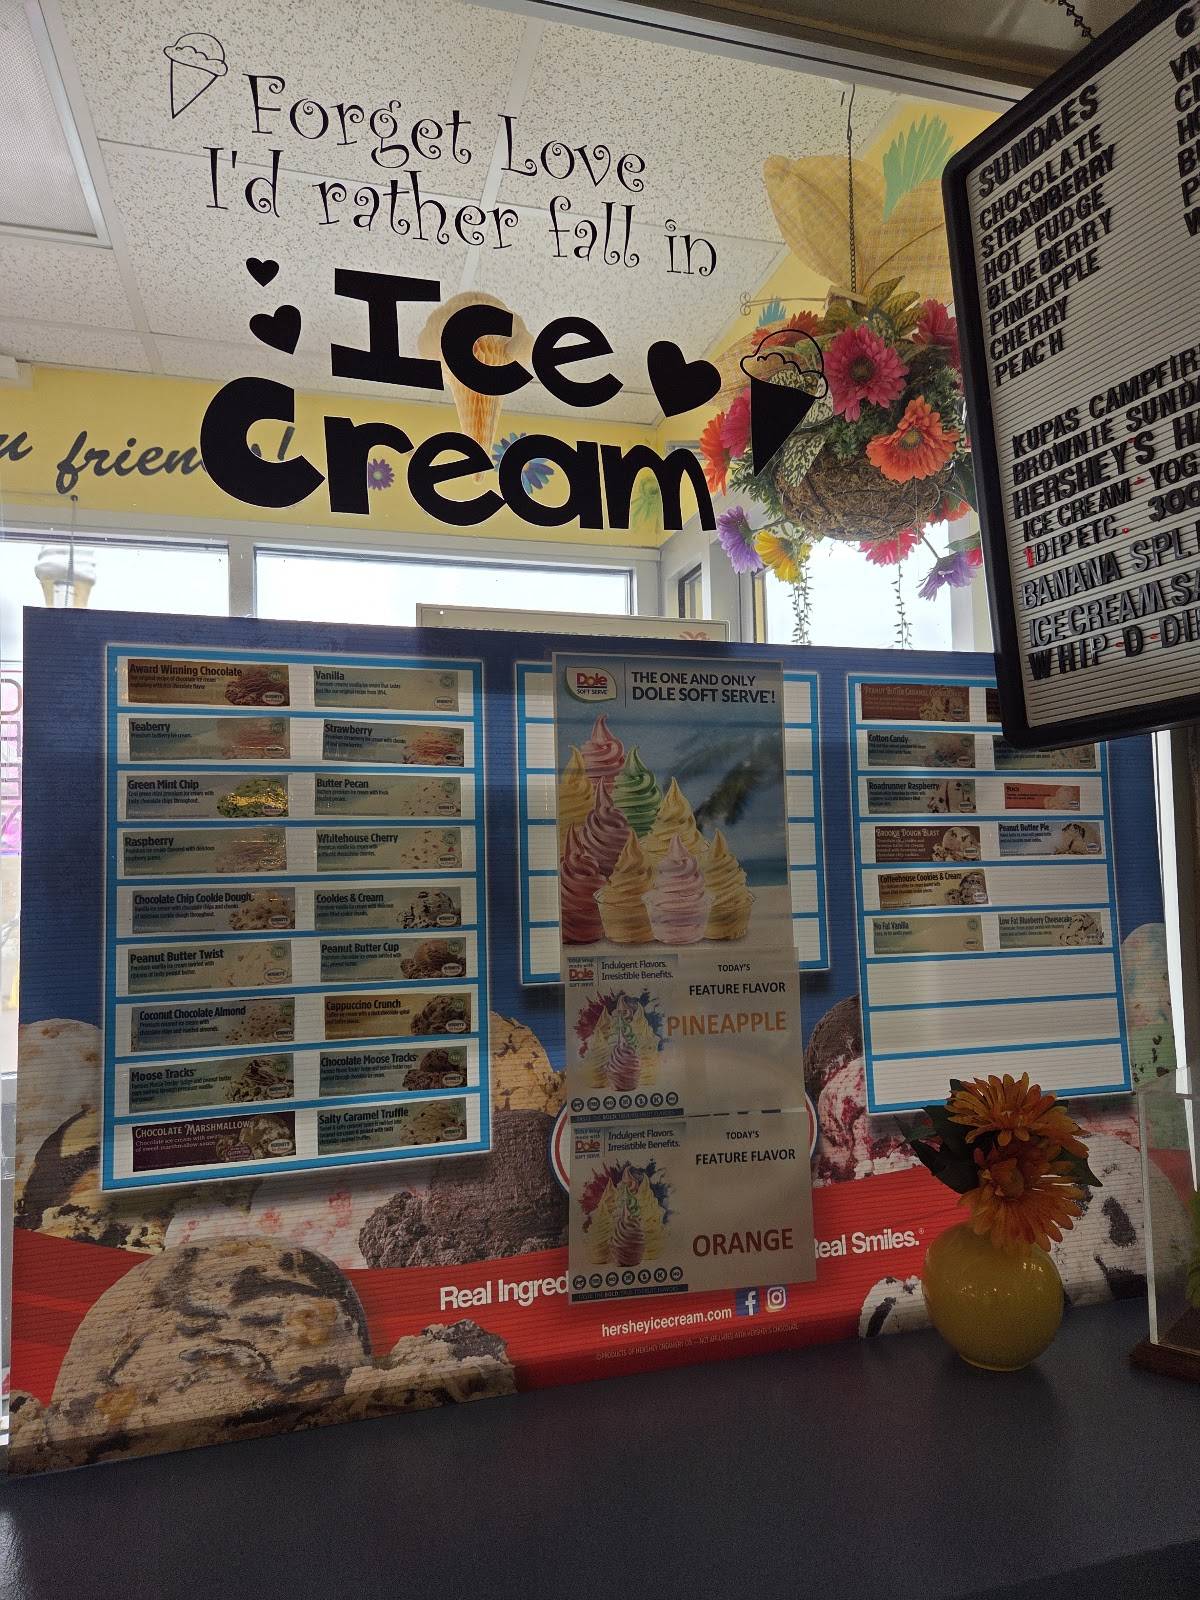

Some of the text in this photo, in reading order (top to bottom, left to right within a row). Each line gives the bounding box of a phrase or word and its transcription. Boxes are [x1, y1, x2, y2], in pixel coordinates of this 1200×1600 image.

[243, 73, 645, 192] Forget Love
[979, 84, 1100, 197] SUNDAES
[979, 123, 1103, 232] CHOCOLATE
[980, 143, 1117, 258] STRAWBERRY
[203, 146, 717, 277] I'd rather fall in
[984, 183, 1106, 286] HOT FUDGE
[990, 249, 1101, 336] PINEAPPLE
[990, 296, 1069, 361] CHERRY
[331, 268, 623, 408] Ice
[994, 329, 1065, 387] PEACH
[1012, 407, 1081, 458] KUPAS
[200, 377, 717, 531] Cream
[1012, 416, 1115, 486] BROWNIE
[1023, 511, 1054, 543] ICE
[1056, 477, 1132, 529] CREAM
[1021, 521, 1200, 611] BANANA SPL
[129, 664, 242, 677] Award Winning Chocolate
[314, 671, 345, 681] Vanilla
[576, 672, 608, 685] Dole
[632, 671, 756, 687] THE ONE AND ONLY
[632, 686, 674, 701] DOLE
[679, 688, 719, 703] SOFT
[131, 722, 170, 732] Teaberry
[324, 724, 373, 737] Strawberry
[868, 734, 909, 744] Cotton Candy
[128, 779, 199, 791] Green Mint Chip
[317, 779, 369, 789] Butter Pecan
[869, 782, 940, 791] Roadrunner Raspberry
[999, 822, 1050, 832] Peanut Butter Pie
[125, 836, 174, 848] Raspberry
[317, 833, 399, 846] Whitehouse Cherry
[880, 874, 916, 883] Coffeehouse
[916, 873, 938, 882] Cookies
[945, 872, 961, 880] Cream
[135, 894, 175, 905] Chocolate
[176, 893, 194, 905] Chip
[195, 893, 224, 903] Cookie
[316, 893, 384, 904] Cookies & Cream
[892, 921, 909, 930] Vanilla
[321, 942, 399, 954] Peanut Butter Cup
[130, 949, 224, 964] Peanut Butter Twist
[601, 961, 639, 971] Indulgent
[718, 963, 750, 972] TODAY'S
[569, 968, 594, 980] Dole
[601, 970, 674, 981] Irresistible Benefits.
[689, 982, 786, 996] FEATURE FLAVOR
[326, 998, 401, 1011] Cappuccino Crunch
[140, 1005, 246, 1021] Coconut Chocolate Almond
[667, 1011, 787, 1037] PINEAPPLE
[320, 1052, 417, 1067] Chocolate Moose Tracks
[131, 1068, 194, 1082] Moose Tracks
[319, 1107, 409, 1125] Salty Caramel Truffle
[135, 1120, 250, 1138] CHOCOLATE MARSHMALLOW
[608, 1129, 646, 1141] Indulgent
[726, 1130, 760, 1140] TODAY'S
[576, 1139, 600, 1151] Dole
[608, 1139, 681, 1152] Irresistible Benefits.
[695, 1149, 796, 1165] FEATURE FLAVOR
[692, 1228, 793, 1258] ORANGE
[440, 1280, 492, 1310] Real
[851, 1228, 920, 1254] Smiles.
[602, 1306, 732, 1337] hersheyicecream.com
